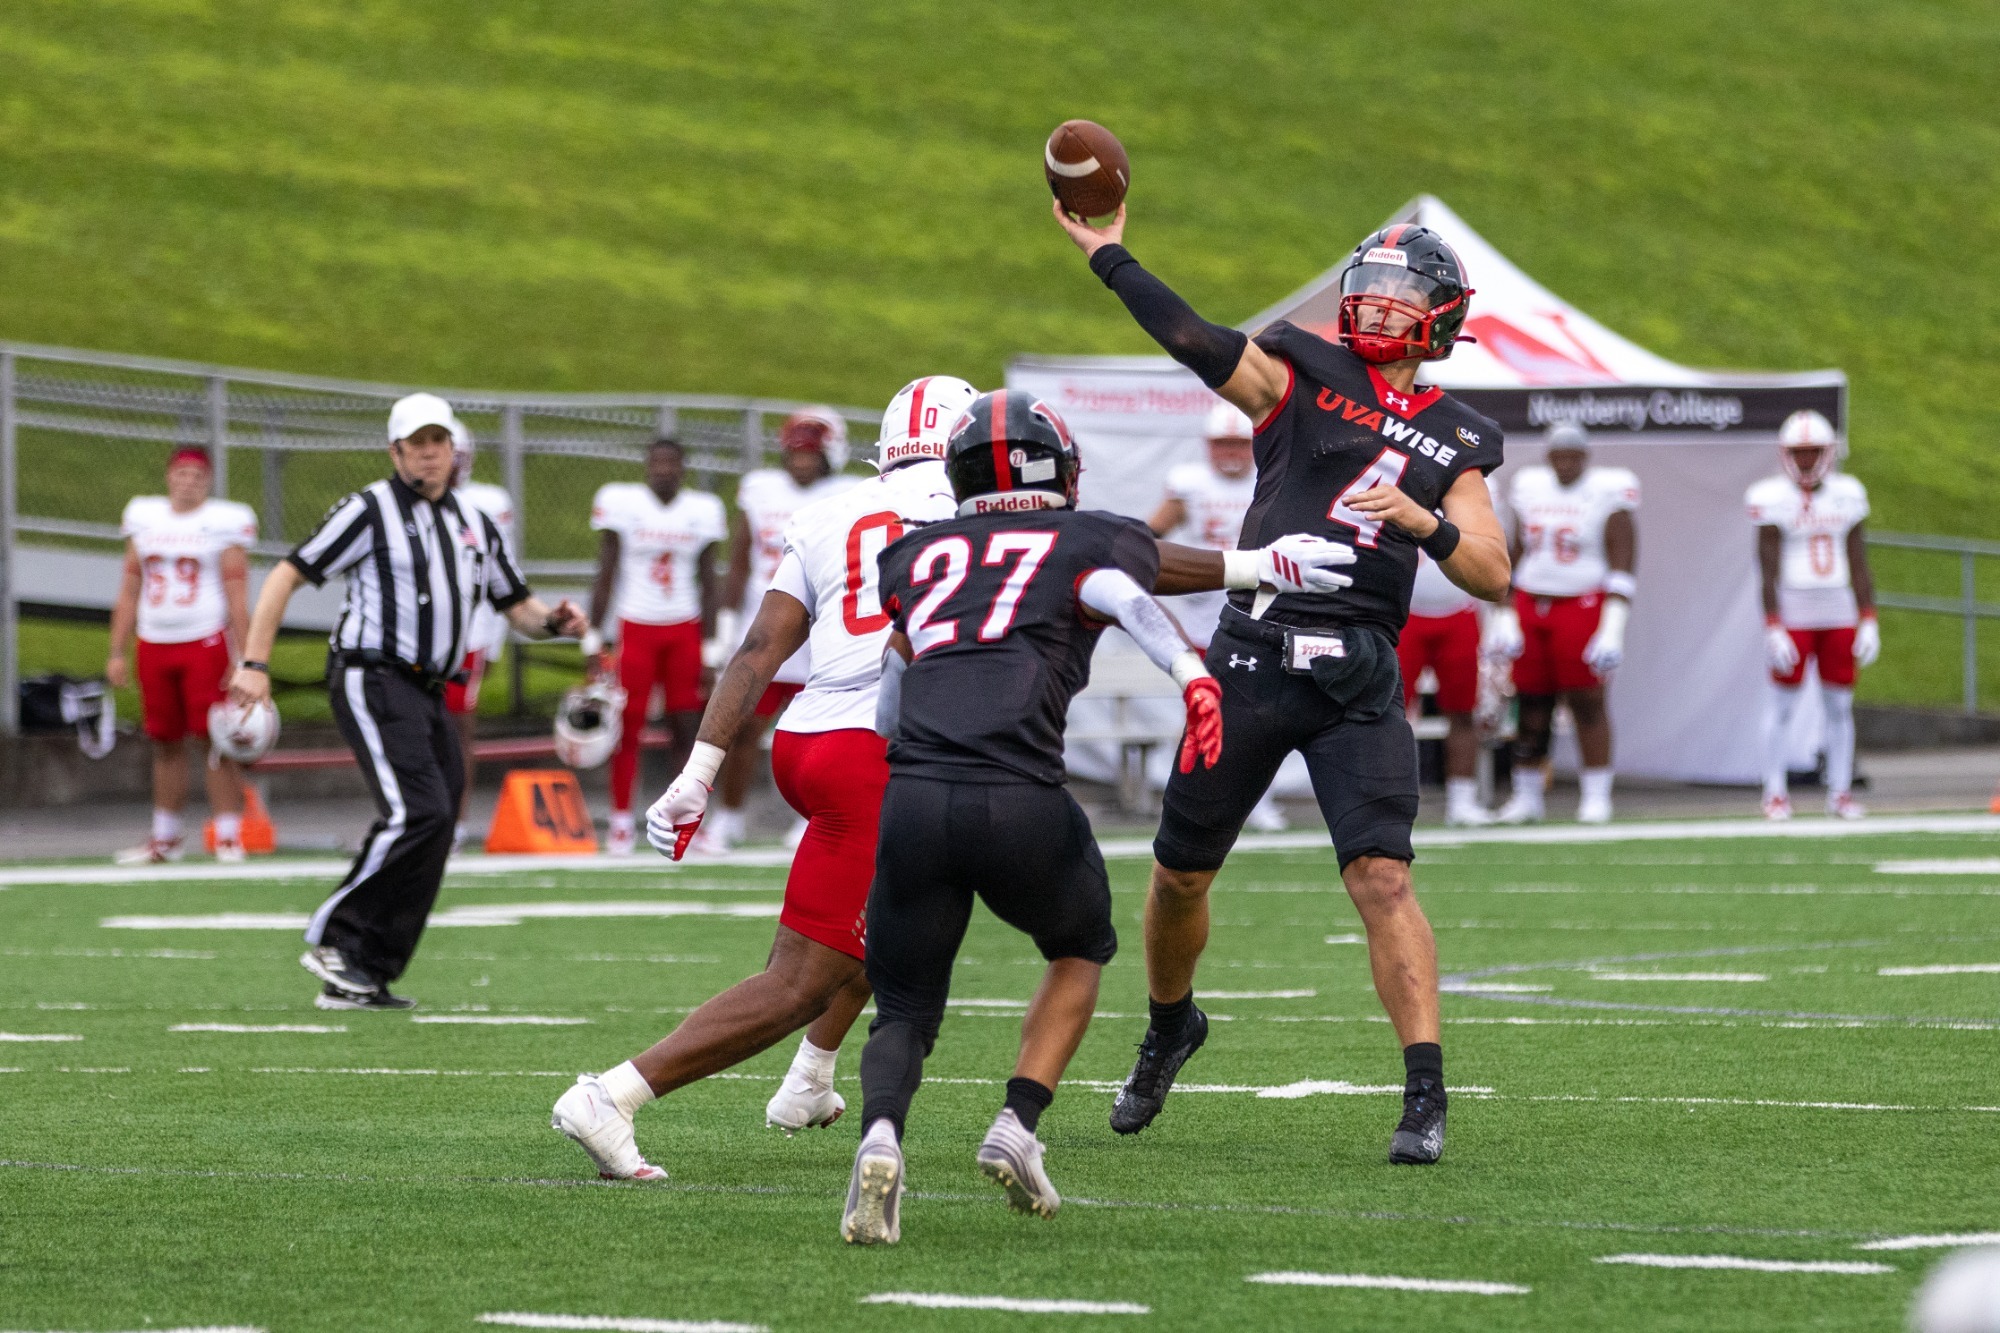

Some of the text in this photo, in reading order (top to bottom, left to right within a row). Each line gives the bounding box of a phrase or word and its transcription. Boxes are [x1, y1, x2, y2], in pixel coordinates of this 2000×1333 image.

[1367, 251, 1404, 262] Riddell
[924, 407, 938, 429] 0
[1528, 390, 1743, 431] Newberry College
[1316, 386, 1458, 467] UVAWISE
[1459, 426, 1481, 447] SAC
[887, 441, 944, 461] Riddell
[1011, 451, 1025, 466] 27
[975, 495, 1044, 514] Riddell
[1326, 445, 1411, 549] 4
[1808, 533, 1835, 578] 0
[906, 529, 1060, 660] 27
[531, 782, 587, 840] 40
